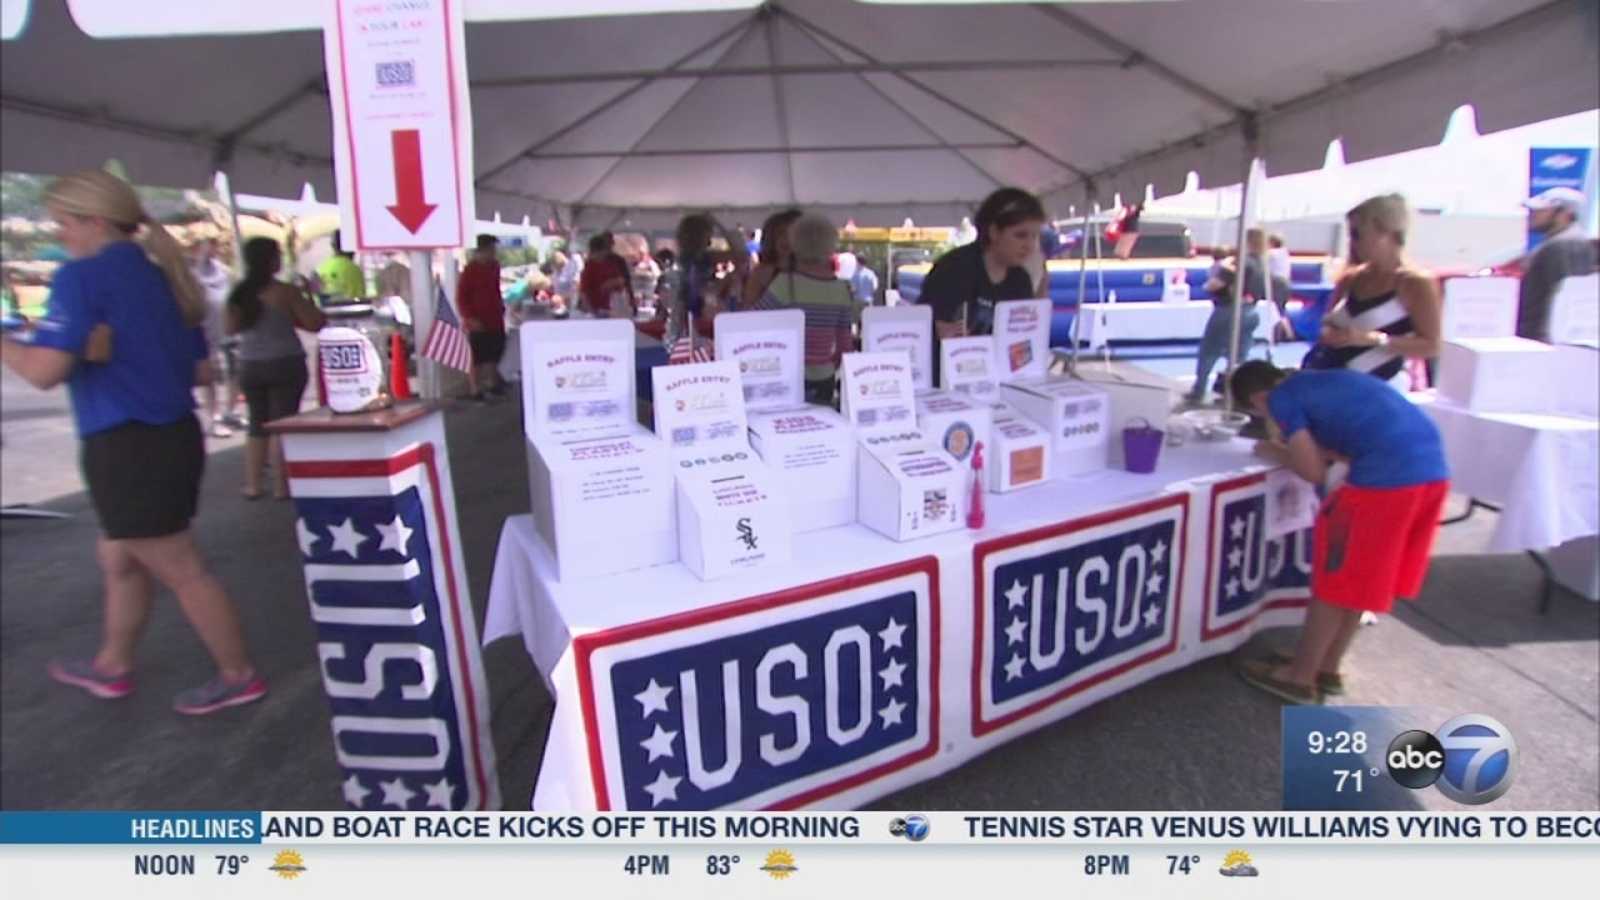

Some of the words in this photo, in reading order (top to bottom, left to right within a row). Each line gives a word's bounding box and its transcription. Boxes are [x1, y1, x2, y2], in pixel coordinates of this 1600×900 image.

[733, 342, 761, 355] RAFFLE
[763, 342, 788, 350] ENTRY
[547, 356, 582, 368] RAFFLE
[584, 354, 616, 365] ENTRY
[853, 364, 878, 377] RAFFLE
[880, 364, 904, 373] ENTRY
[666, 376, 699, 391] RAFFLE
[701, 375, 731, 384] ENTRY
[1030, 543, 1146, 672] USO
[303, 558, 451, 771] USO
[680, 624, 872, 792] USO
